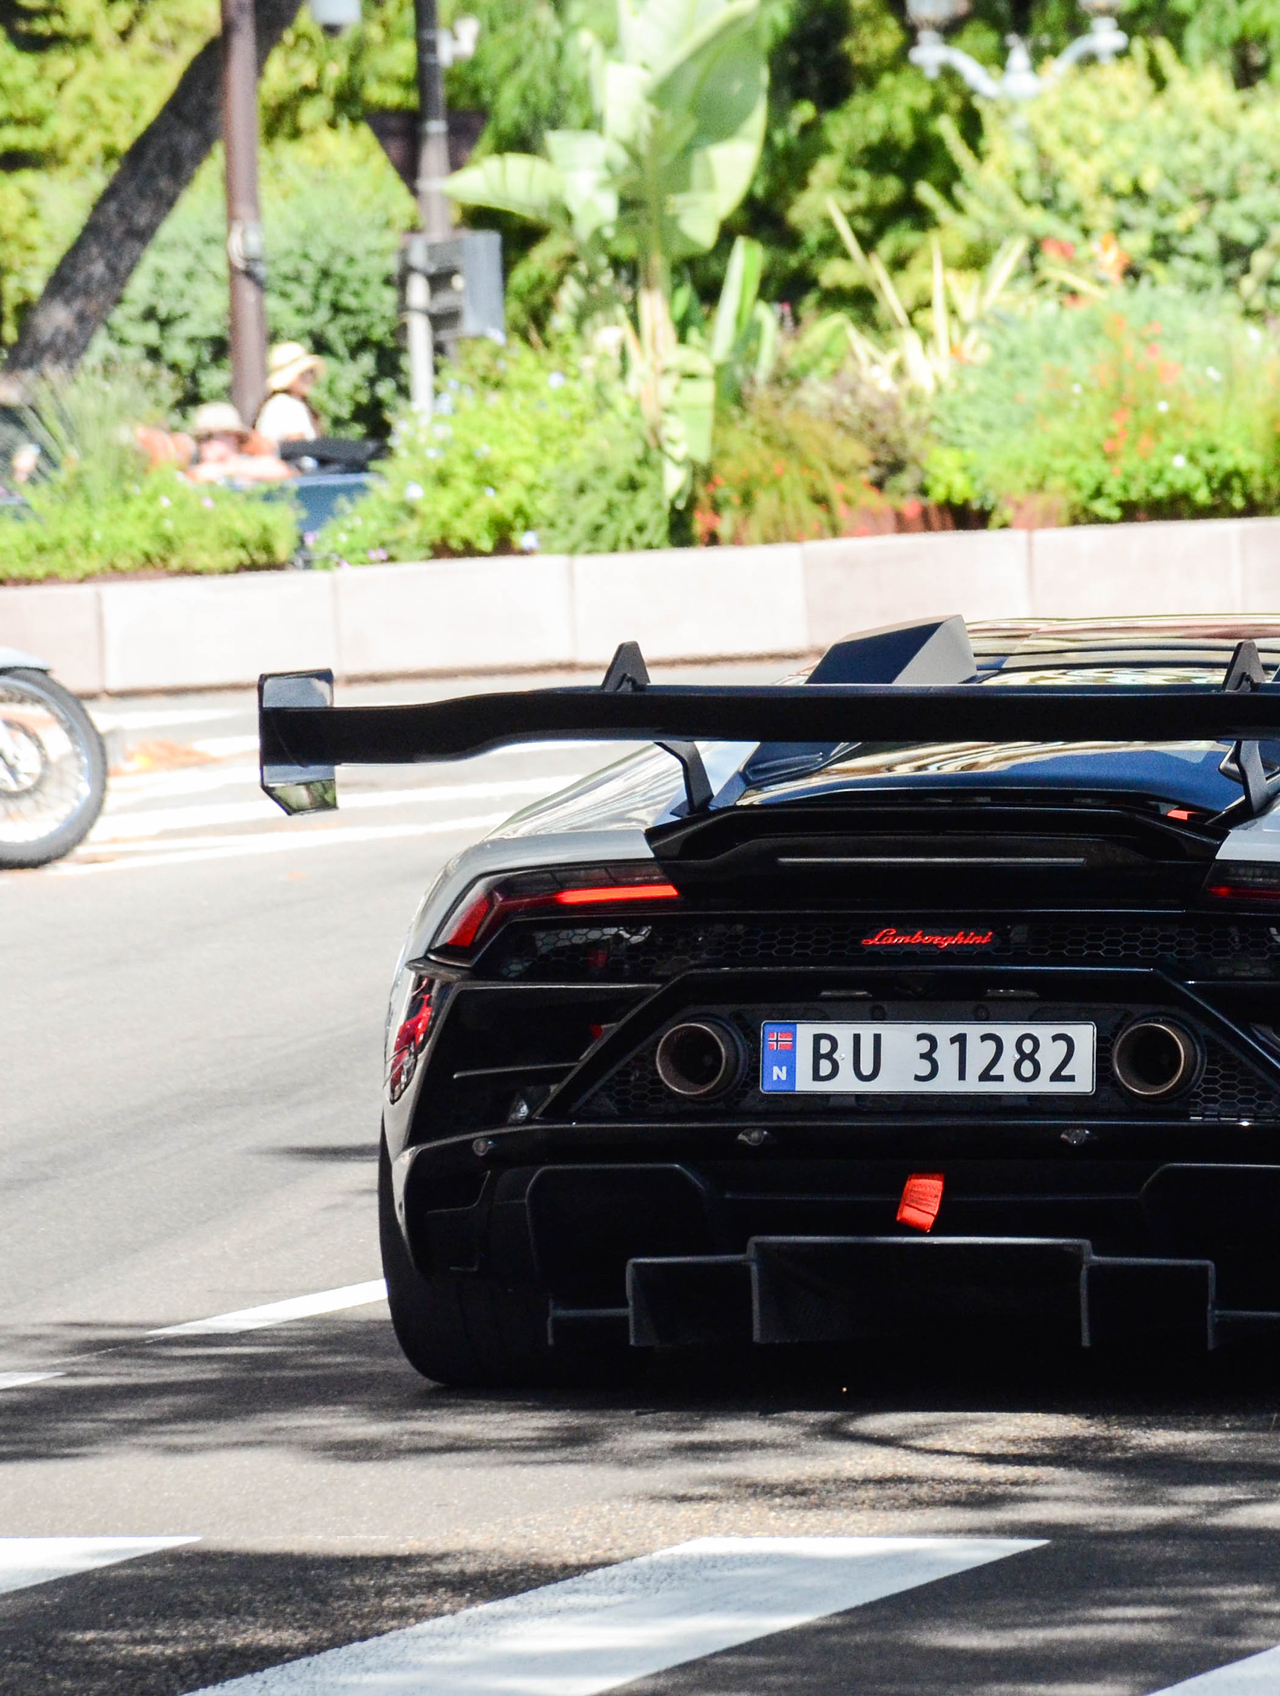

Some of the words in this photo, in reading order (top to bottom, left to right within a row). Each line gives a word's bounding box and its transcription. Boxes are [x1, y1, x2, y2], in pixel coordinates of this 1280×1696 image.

[861, 928, 994, 949] Lamborghini
[812, 1032, 882, 1082] BU
[913, 1032, 1077, 1083] 31282
[772, 1065, 788, 1081] N
